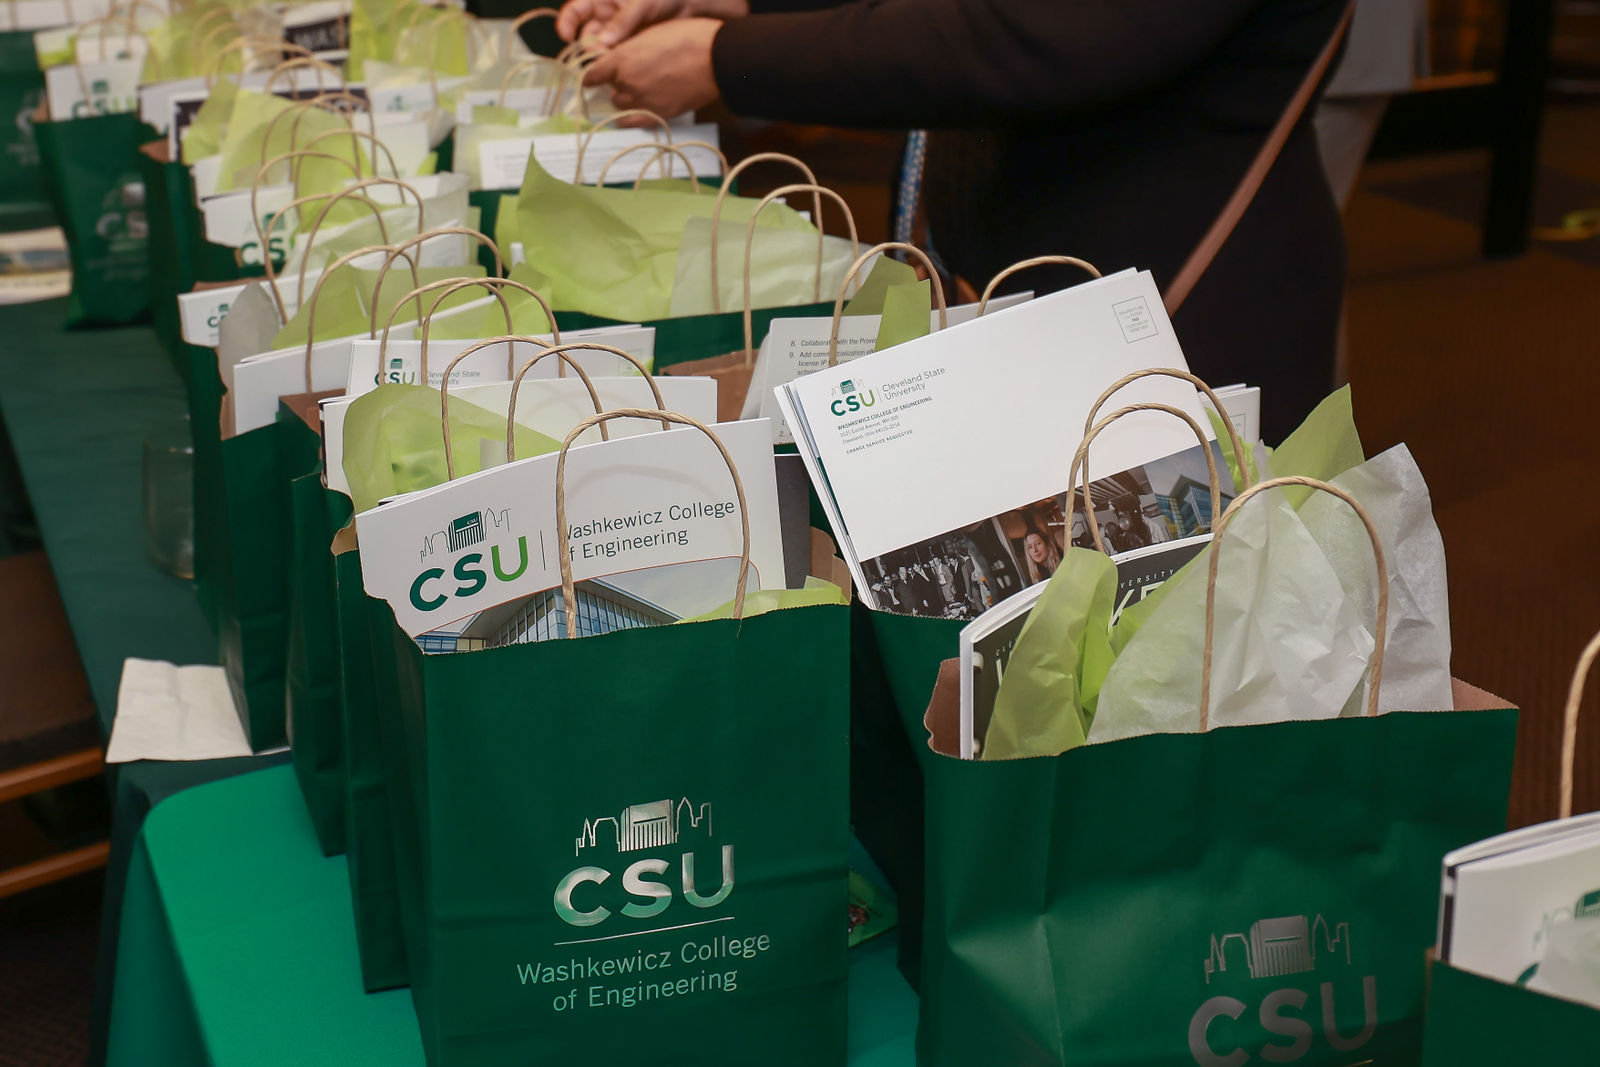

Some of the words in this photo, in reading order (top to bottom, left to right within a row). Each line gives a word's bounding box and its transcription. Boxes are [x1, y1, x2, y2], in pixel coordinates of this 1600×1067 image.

[801, 338, 832, 347] Collaborat
[882, 373, 923, 393] Cleveland
[923, 367, 946, 379] State
[884, 382, 926, 400] University
[830, 389, 876, 416] CSU
[870, 409, 892, 420] COLLEGE
[899, 396, 933, 411] ENGINEERING
[669, 501, 735, 521] College
[583, 529, 689, 559] Engineering
[409, 535, 529, 612] CSU
[1120, 568, 1174, 589] VERSITY
[553, 844, 735, 927] CSU
[516, 949, 672, 985] Washkewicz
[681, 934, 770, 964] College
[552, 988, 578, 1012] of
[588, 969, 739, 1009] Engineering
[1188, 975, 1379, 1067] CSU
